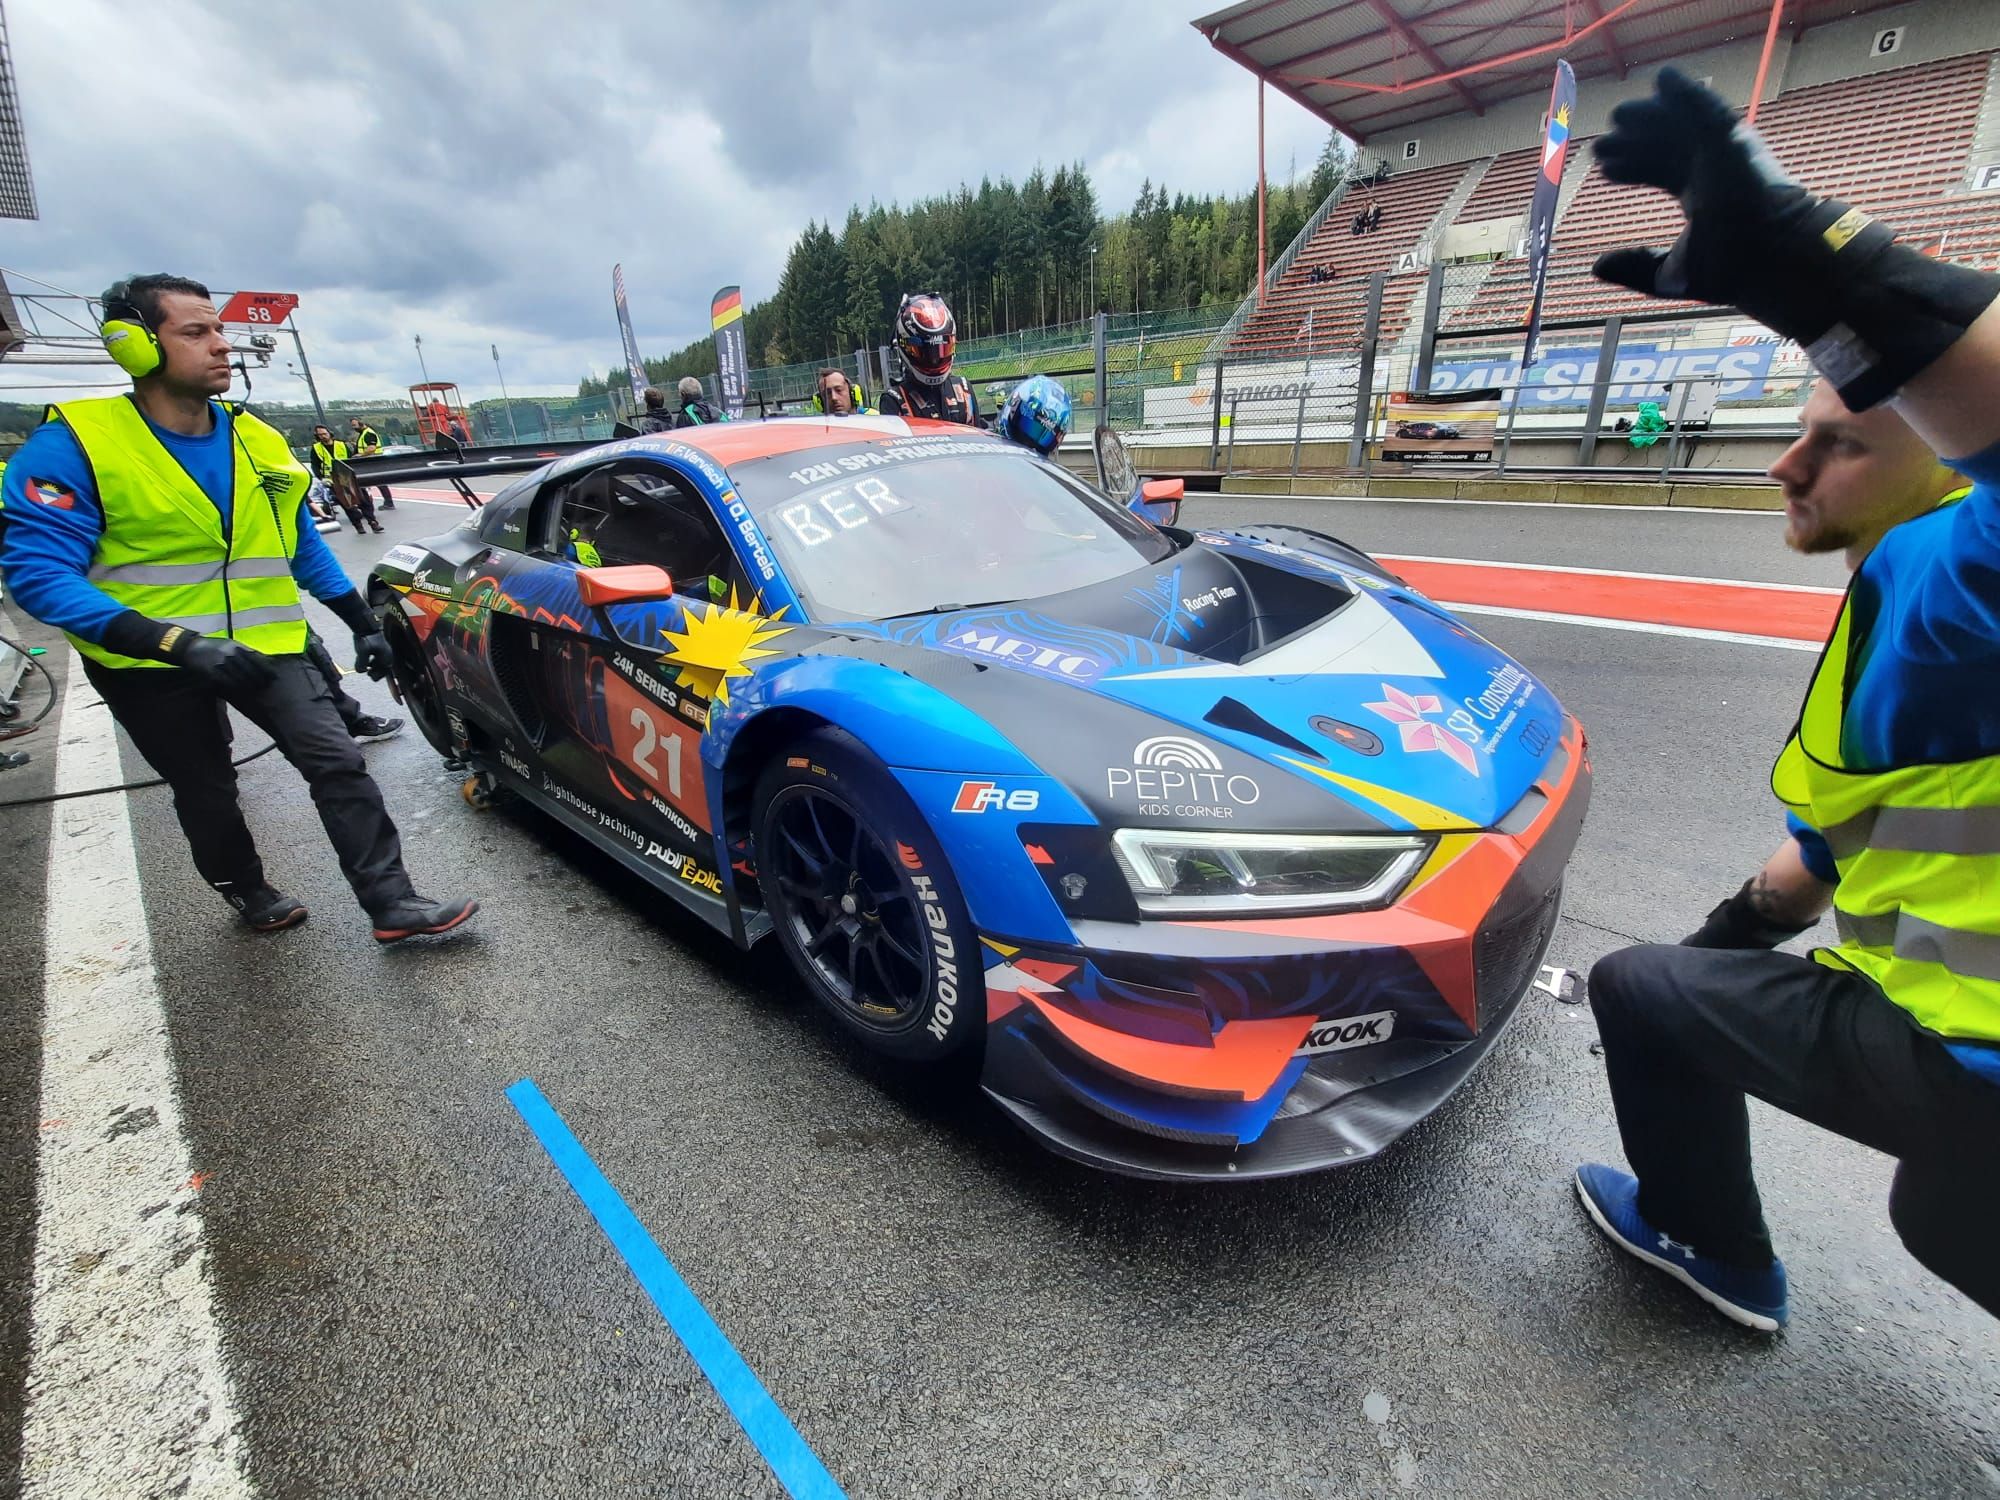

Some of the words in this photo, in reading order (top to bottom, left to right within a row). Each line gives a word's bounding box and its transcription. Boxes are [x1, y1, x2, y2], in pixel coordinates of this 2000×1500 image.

[1878, 30, 1896, 52] G
[1405, 142, 1417, 157] B
[1981, 166, 2000, 188] F
[1401, 255, 1415, 269] A
[247, 306, 271, 322] 58
[788, 463, 842, 486] 12H
[738, 521, 775, 581] Bertels
[1182, 589, 1219, 613] Racing
[1214, 585, 1238, 601] Team
[612, 651, 634, 677] 24H
[635, 668, 677, 708] SERIES
[684, 703, 706, 723] GT3
[1464, 663, 1532, 720] Consulting
[1446, 709, 1485, 744] SP
[630, 707, 682, 800] 21
[972, 787, 1040, 811] R8
[1107, 767, 1260, 805] PEPITO
[550, 779, 597, 818] lighthouse
[599, 811, 645, 849] yachting
[1138, 803, 1170, 816] KIDS
[1175, 804, 1233, 818] CORNER
